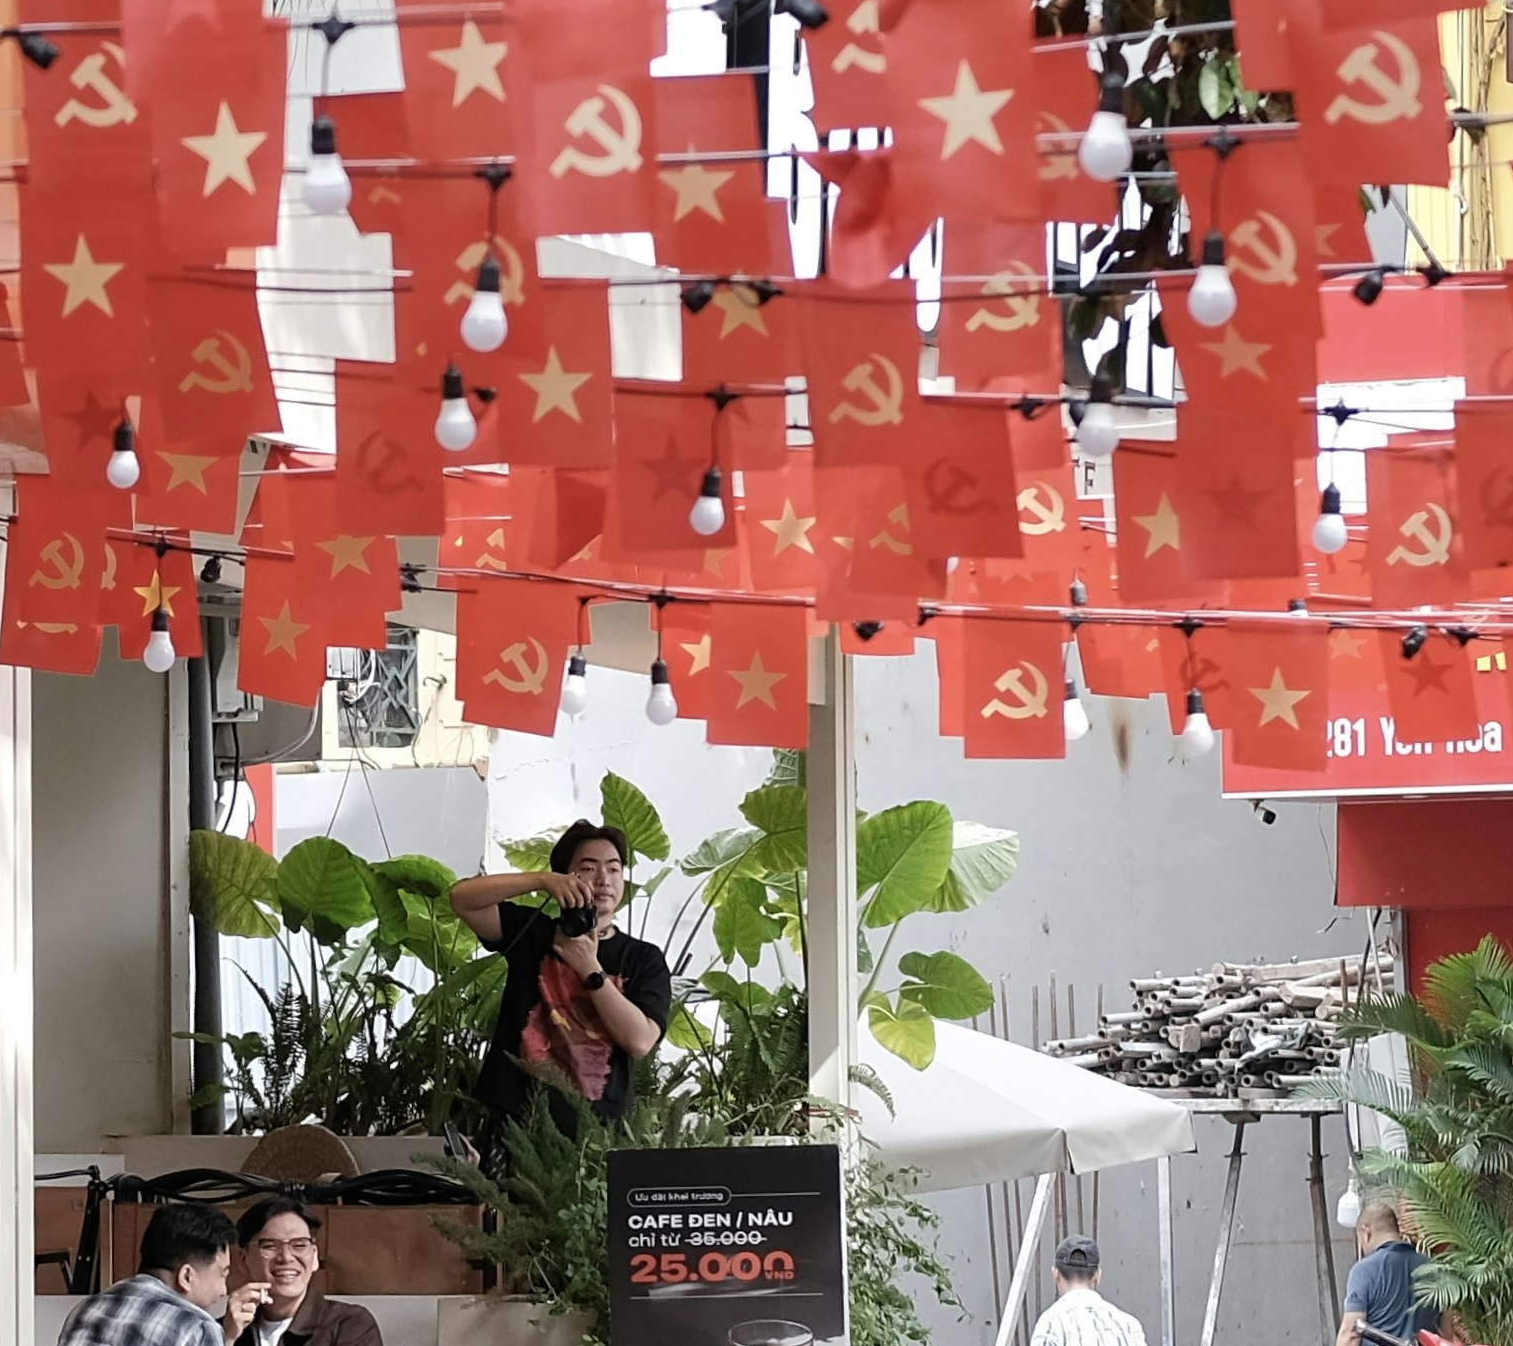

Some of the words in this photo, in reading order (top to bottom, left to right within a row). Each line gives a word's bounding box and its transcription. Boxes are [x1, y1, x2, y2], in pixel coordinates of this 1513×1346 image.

[628, 1214, 683, 1229] CAFE
[688, 1212, 731, 1228] ĐEN
[748, 1208, 794, 1226] NÂU
[630, 1250, 795, 1284] 25.000
